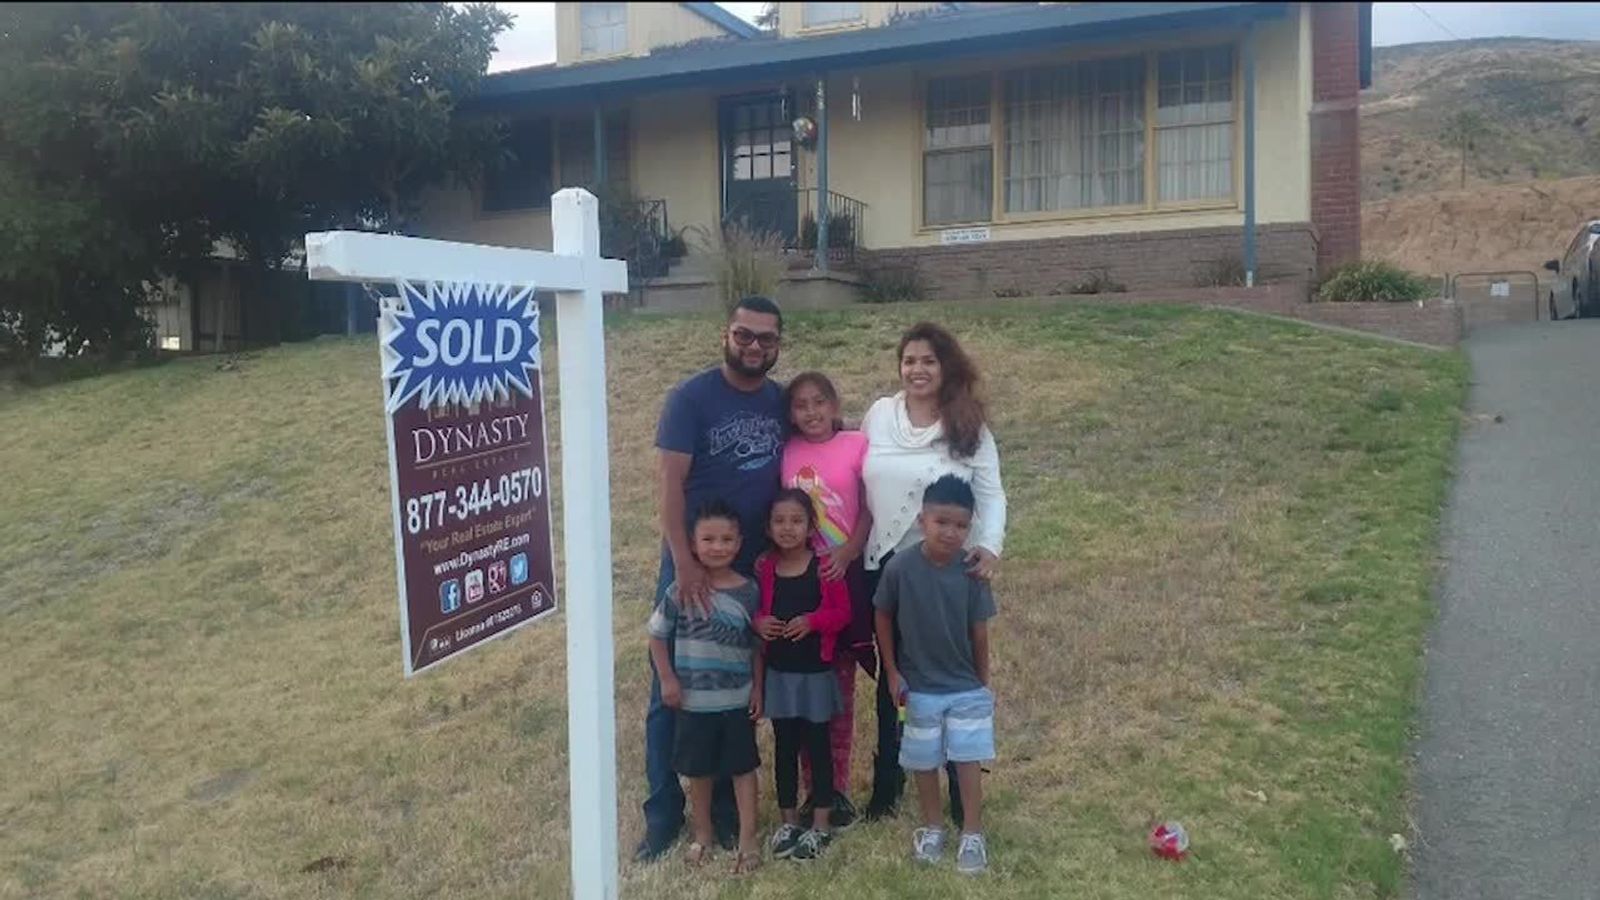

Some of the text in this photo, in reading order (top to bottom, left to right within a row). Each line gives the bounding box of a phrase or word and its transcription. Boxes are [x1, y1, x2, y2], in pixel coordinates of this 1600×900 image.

[412, 318, 522, 367] SOLD
[411, 413, 529, 463] DYNASTY
[406, 466, 542, 534] 877-344-0570
[433, 532, 531, 576] www.DynastyRE.com
[451, 526, 474, 547] Real
[475, 518, 503, 539] Estate
